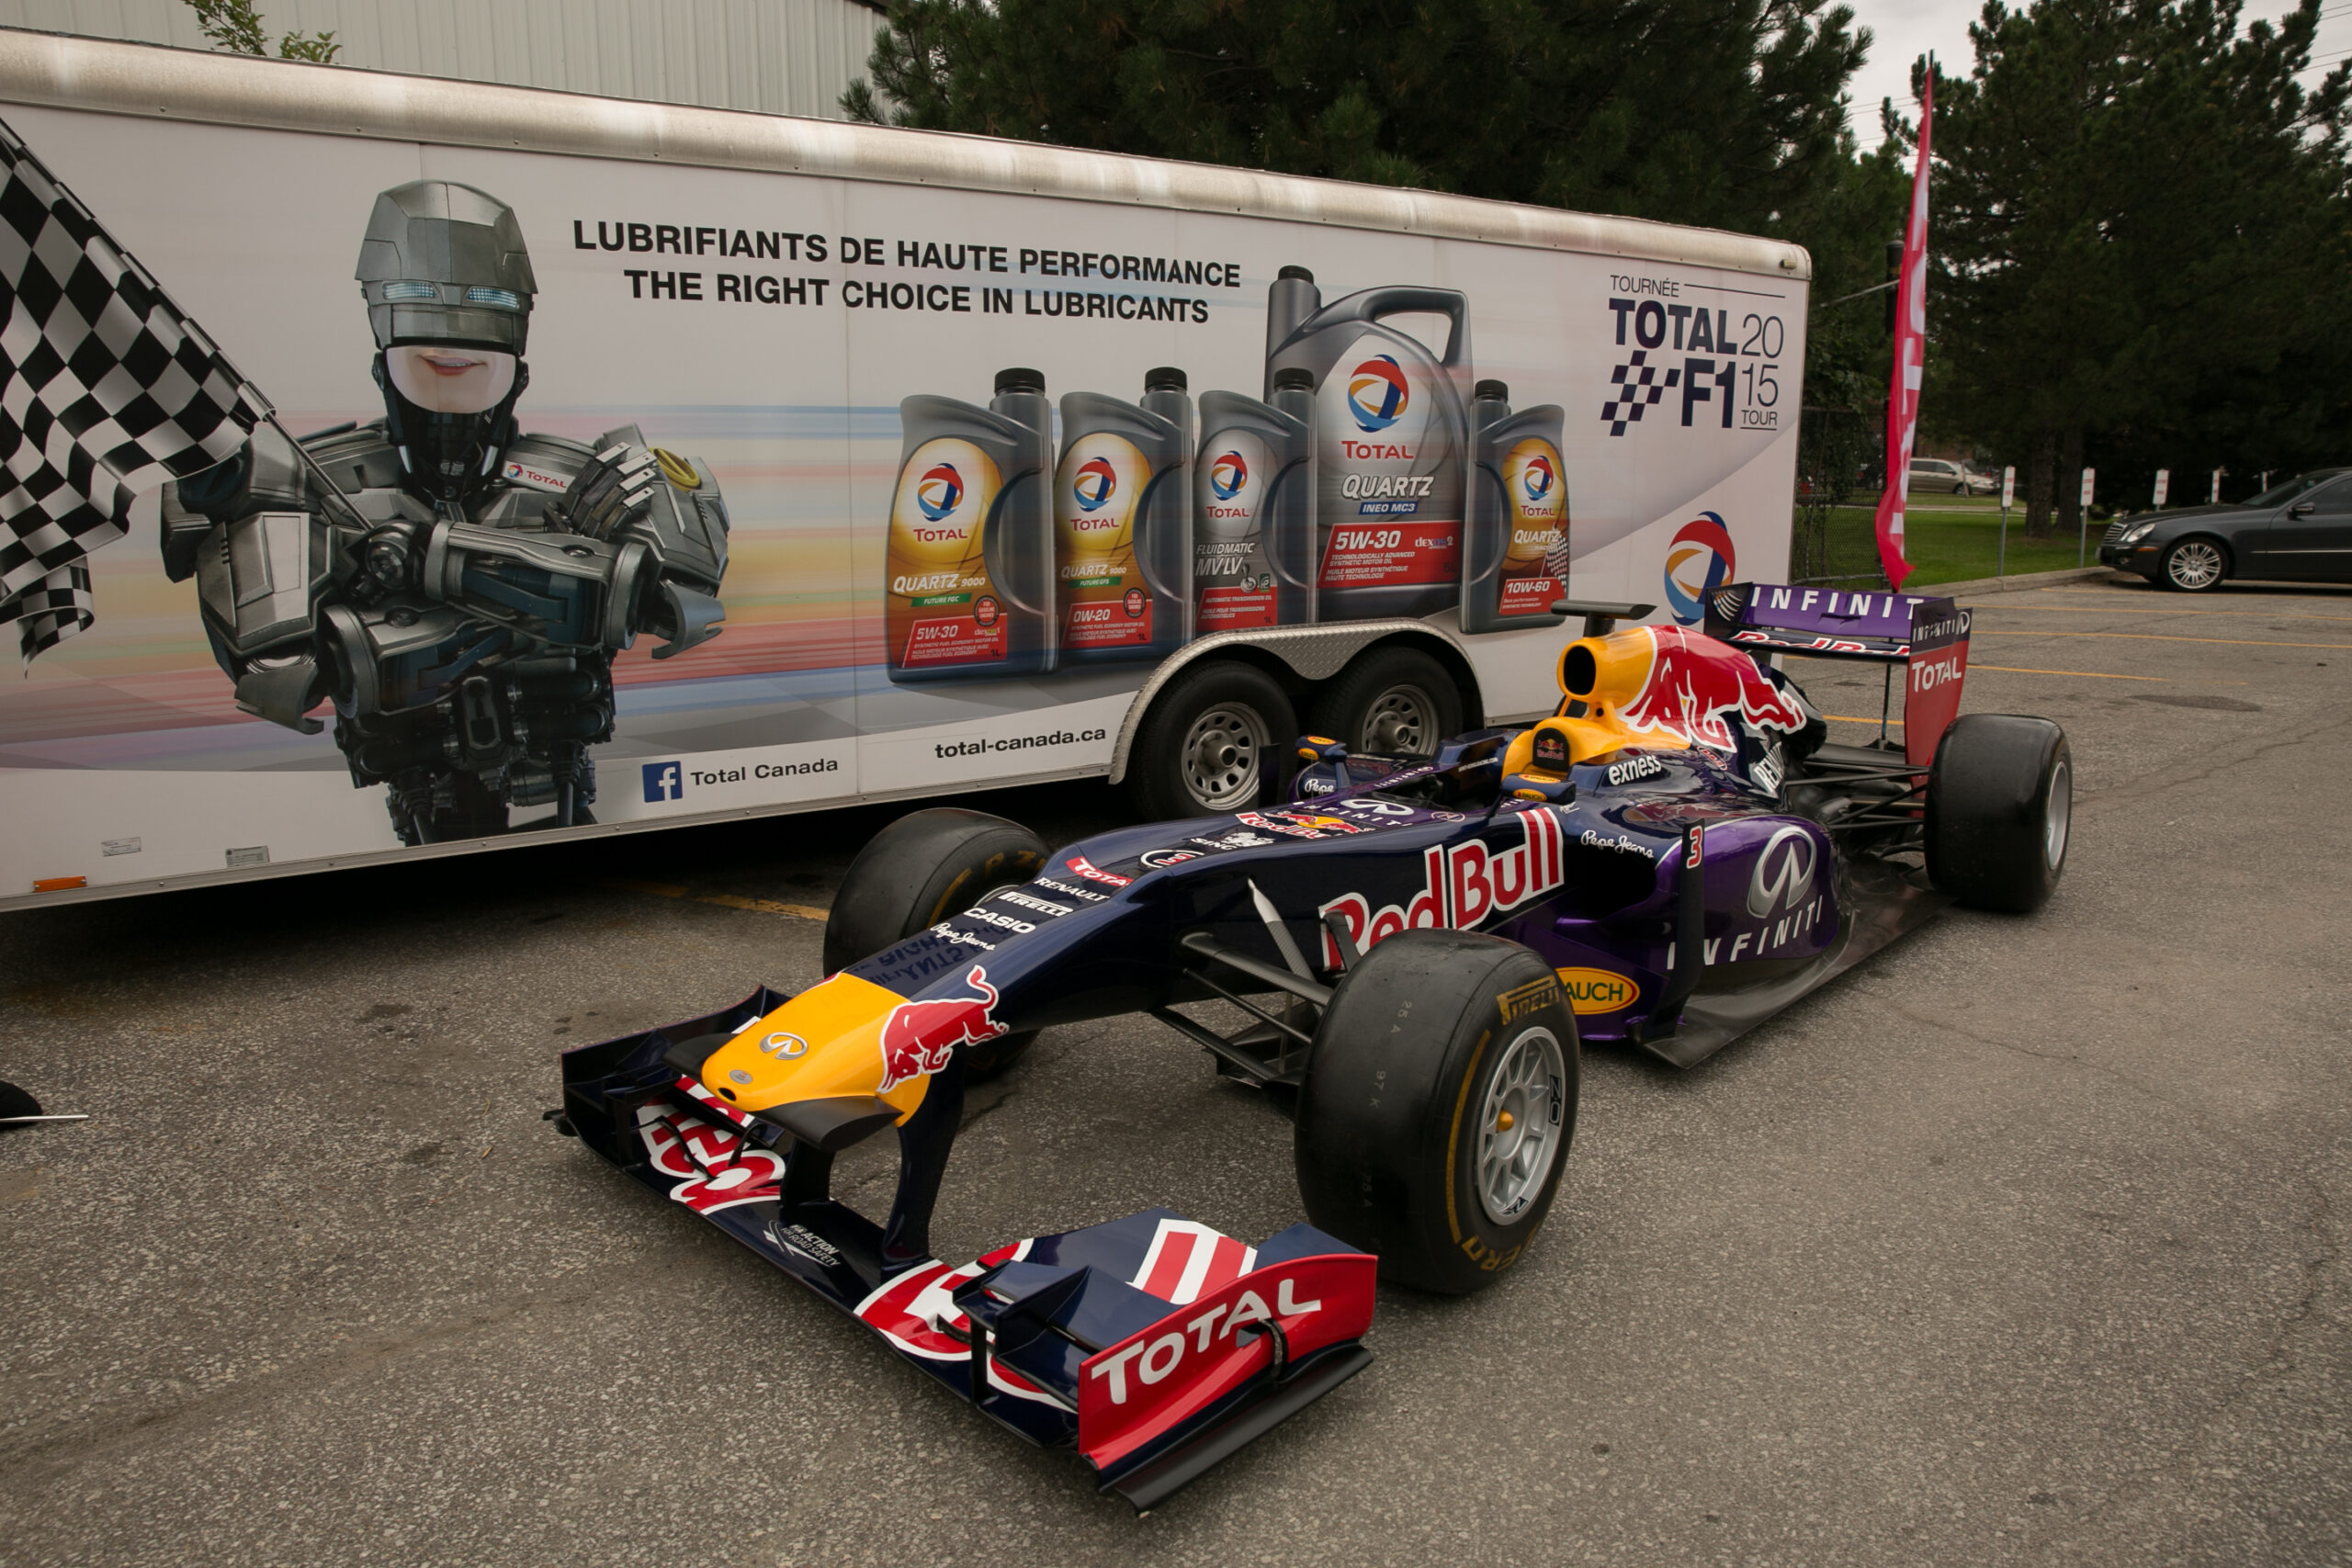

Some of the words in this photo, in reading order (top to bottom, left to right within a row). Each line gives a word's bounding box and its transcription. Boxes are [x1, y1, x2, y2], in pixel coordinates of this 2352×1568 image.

[573, 220, 828, 263] LUBRIFIANTS
[841, 237, 885, 265] DE
[898, 241, 1009, 273] HAUTE
[1020, 248, 1240, 288] PERFORMANCE
[624, 270, 704, 301] THE
[717, 274, 829, 306] RIGHT
[842, 280, 971, 312] CHOICE
[982, 288, 1012, 314] IN
[1024, 290, 1208, 323] LUBRICANTS
[1611, 275, 1679, 298] TOURNÉE
[1609, 298, 1737, 355] TOTAL
[1741, 313, 1784, 358] 20
[1681, 357, 1736, 429] F1
[1742, 363, 1779, 407] 15
[1742, 410, 1778, 426] TOUR
[1341, 441, 1414, 459] TOTAL
[526, 470, 567, 489] TOTAL
[1341, 473, 1434, 500] QUARTZ
[1206, 506, 1250, 518] TOTAL
[1363, 504, 1389, 513] INEO
[1391, 503, 1415, 512] MC3
[1521, 505, 1555, 516] TOTAL
[913, 528, 967, 542] TOTAL
[1070, 518, 1119, 531] TOTAL
[1514, 529, 1561, 544] QUARTZ
[1196, 543, 1255, 555] FLUIDMATIC
[1335, 530, 1401, 550] 5W-30
[893, 574, 958, 592] QUARTZ
[961, 577, 985, 588] 9000
[1061, 564, 1108, 578] QUARTZ
[1508, 581, 1550, 593] 10W-60
[1073, 609, 1110, 622] 0W-20
[1750, 587, 1924, 620] INFINIT
[916, 626, 958, 640] 5W-30
[1912, 657, 1962, 692] TOTAL
[935, 728, 1105, 759] total-canada.ca
[691, 768, 746, 787] Total
[755, 758, 838, 779] Canada
[1609, 755, 1662, 786] exness
[1305, 778, 1334, 795] Pepe
[1191, 837, 1240, 851] SING
[1581, 829, 1615, 850] Pepe
[1614, 835, 1654, 859] Jeans
[1687, 826, 1702, 870] 3
[1034, 877, 1110, 902] RENAULT
[999, 892, 1073, 917] PIRELLI
[964, 908, 1036, 933] CASIO
[931, 922, 958, 939] Pepe
[950, 932, 996, 951] Jeans
[1496, 975, 1560, 1026] PIRELLI
[1565, 976, 1623, 1001] AUCH
[788, 1234, 813, 1249] ROAD
[808, 1247, 841, 1266] SAFETY
[800, 1232, 840, 1254] ACTION
[1091, 1279, 1321, 1404] TOTAL
